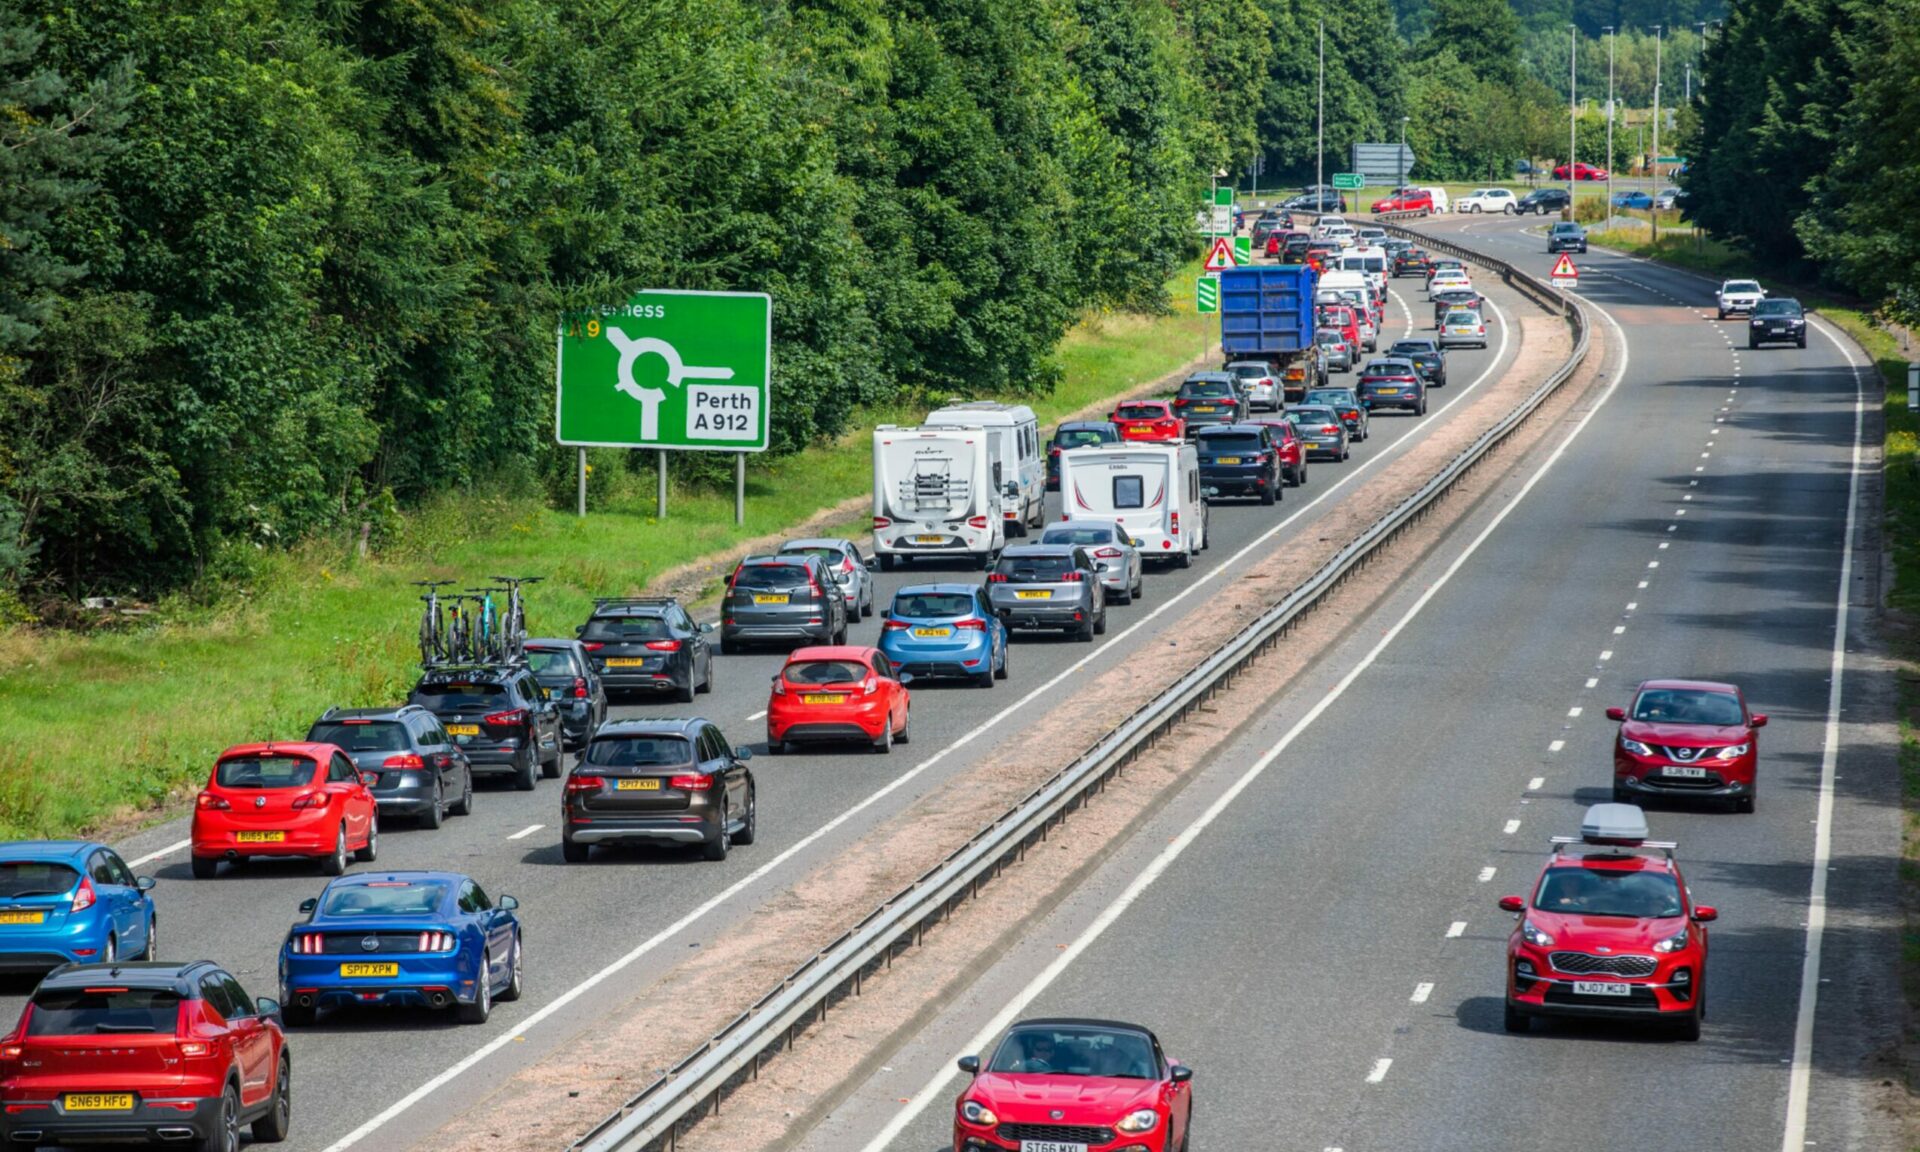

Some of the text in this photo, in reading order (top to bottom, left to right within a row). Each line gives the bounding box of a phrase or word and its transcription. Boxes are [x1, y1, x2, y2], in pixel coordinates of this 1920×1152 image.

[587, 320, 600, 337] 9
[696, 392, 751, 410] Perth
[620, 780, 639, 789] SP17
[347, 964, 392, 975] SP17 XPM
[1579, 982, 1605, 992] NJ07
[70, 1094, 127, 1107] SN69 HFG
[1026, 1142, 1057, 1152] ST66
